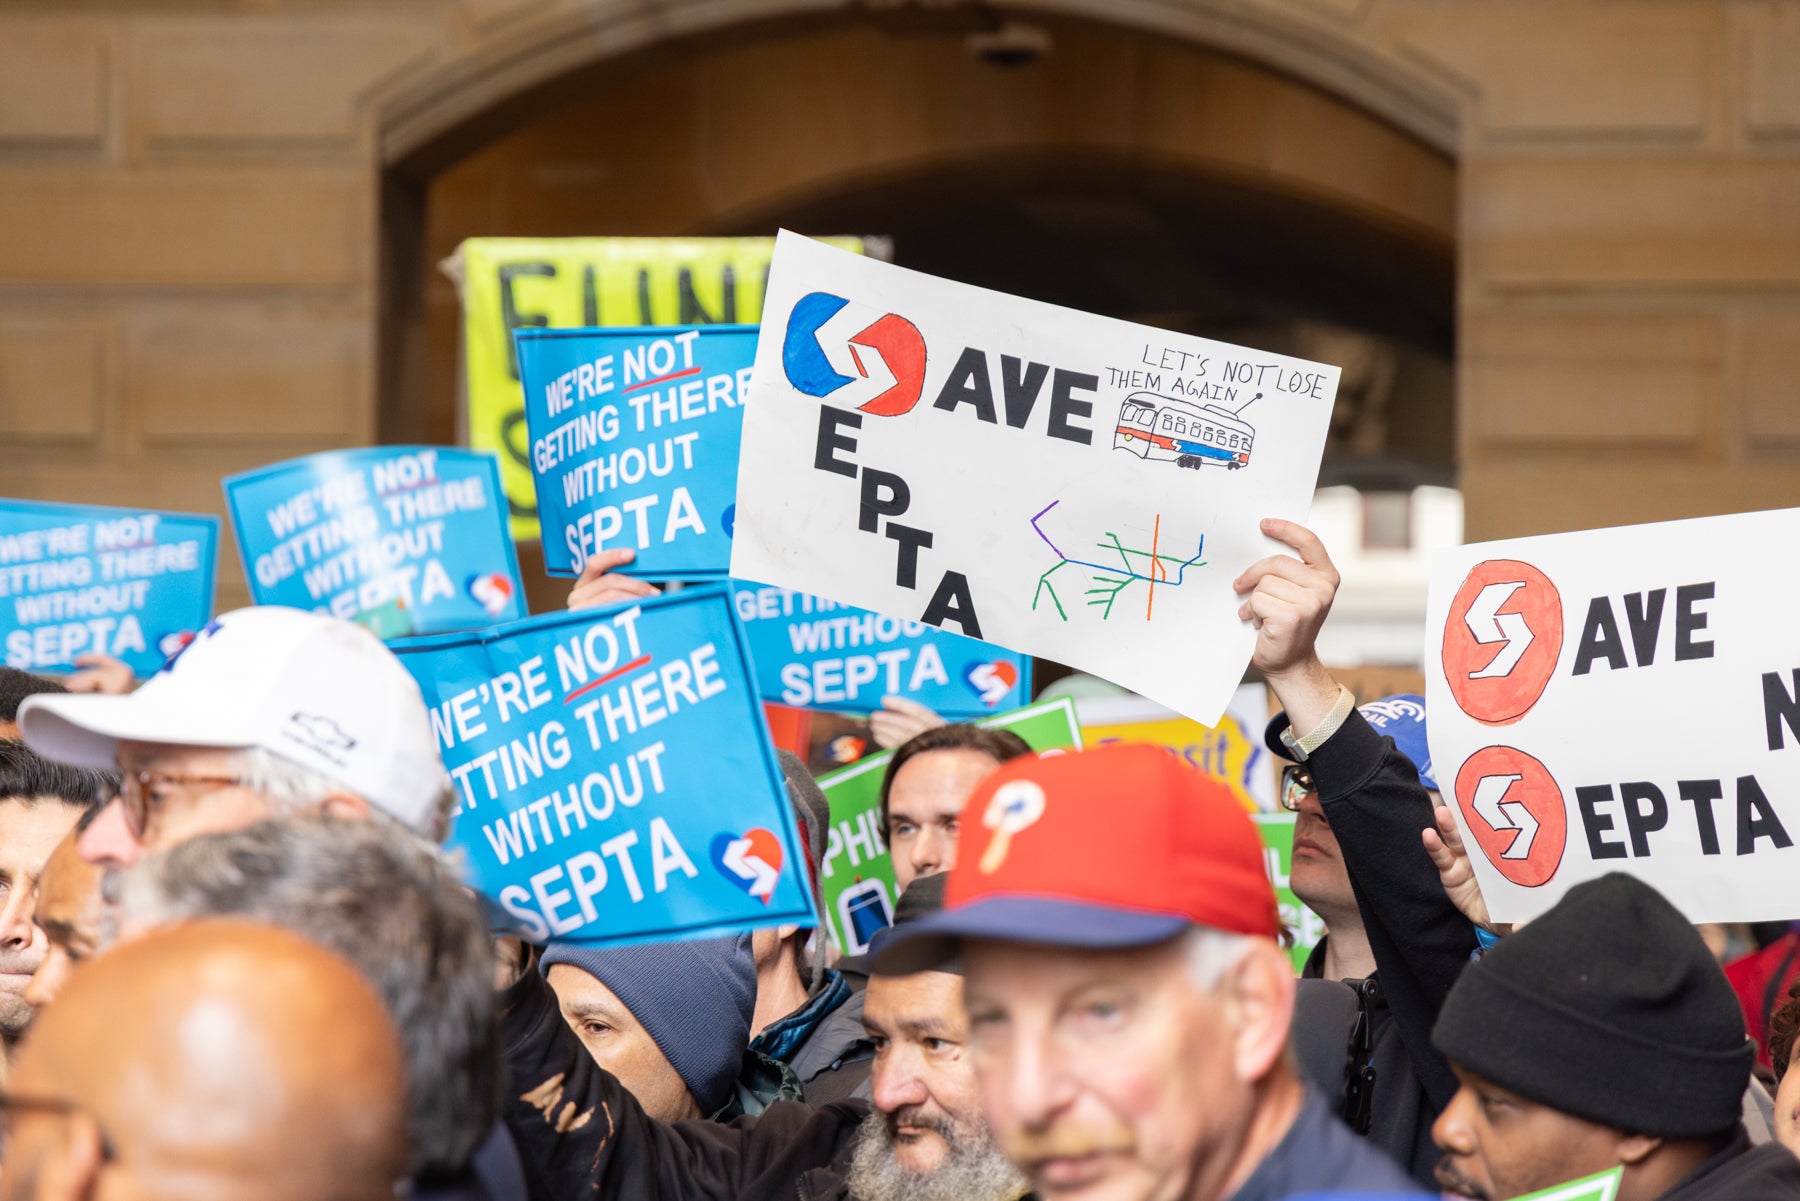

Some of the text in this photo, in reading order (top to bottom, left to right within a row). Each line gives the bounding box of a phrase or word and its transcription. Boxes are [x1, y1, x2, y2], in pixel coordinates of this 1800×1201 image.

[545, 330, 700, 418] WE'RE NOT
[1105, 366, 1238, 401] THEM AGAIN
[1142, 344, 1328, 400] LET'S NOT LOSE
[372, 450, 438, 494] NOT
[534, 405, 619, 474] GETTING
[563, 432, 699, 508] WITHOUT
[95, 514, 161, 549] NOT
[255, 476, 487, 588] GETTING THERE
[303, 520, 445, 600] WITHOUT
[0, 540, 199, 597] ETTING THERE
[15, 580, 150, 626] WITHOUT
[6, 614, 147, 670] SEPTA
[554, 606, 643, 692] NOT
[781, 643, 949, 706] SEPTA
[575, 642, 727, 752] THERE
[482, 741, 665, 866] WITHOUT
[500, 816, 699, 942] SEPTA
